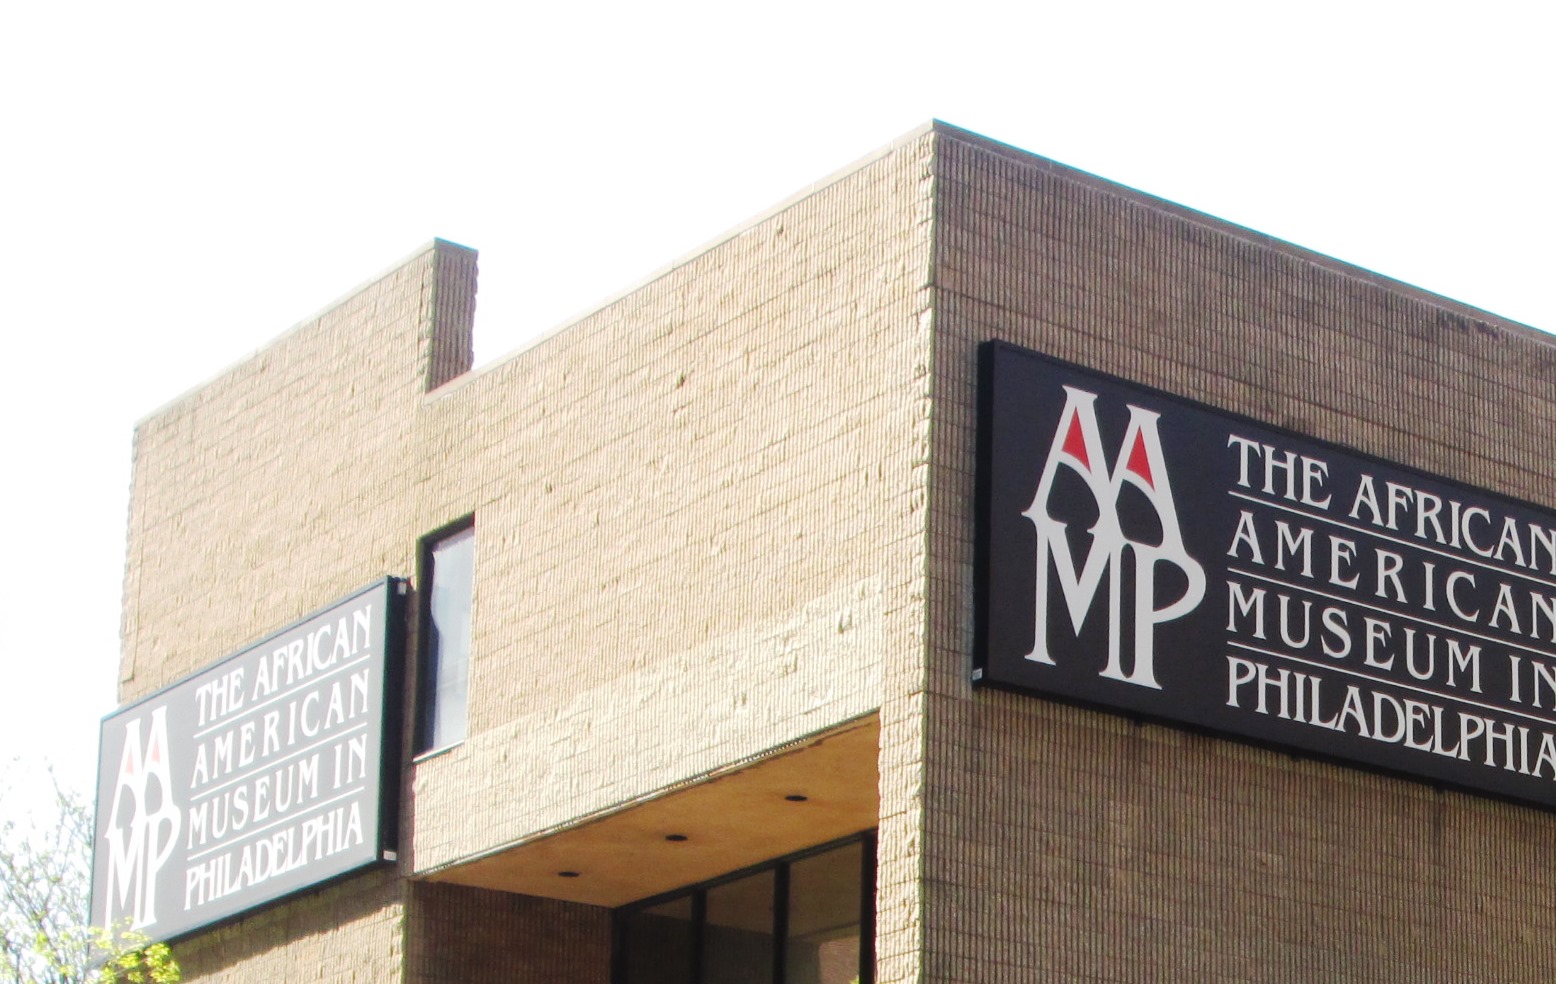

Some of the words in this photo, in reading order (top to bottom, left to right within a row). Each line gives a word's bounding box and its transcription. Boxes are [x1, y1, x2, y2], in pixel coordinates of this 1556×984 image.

[1226, 434, 1332, 510] THE
[195, 667, 244, 727] THE
[252, 604, 372, 702] AFRICAN
[1226, 581, 1483, 694] MUSEUM
[190, 668, 370, 789] AMERICAN
[186, 754, 319, 851] MUSEUM
[333, 733, 368, 789] IN
[184, 801, 364, 911] PHILADELPHIA
